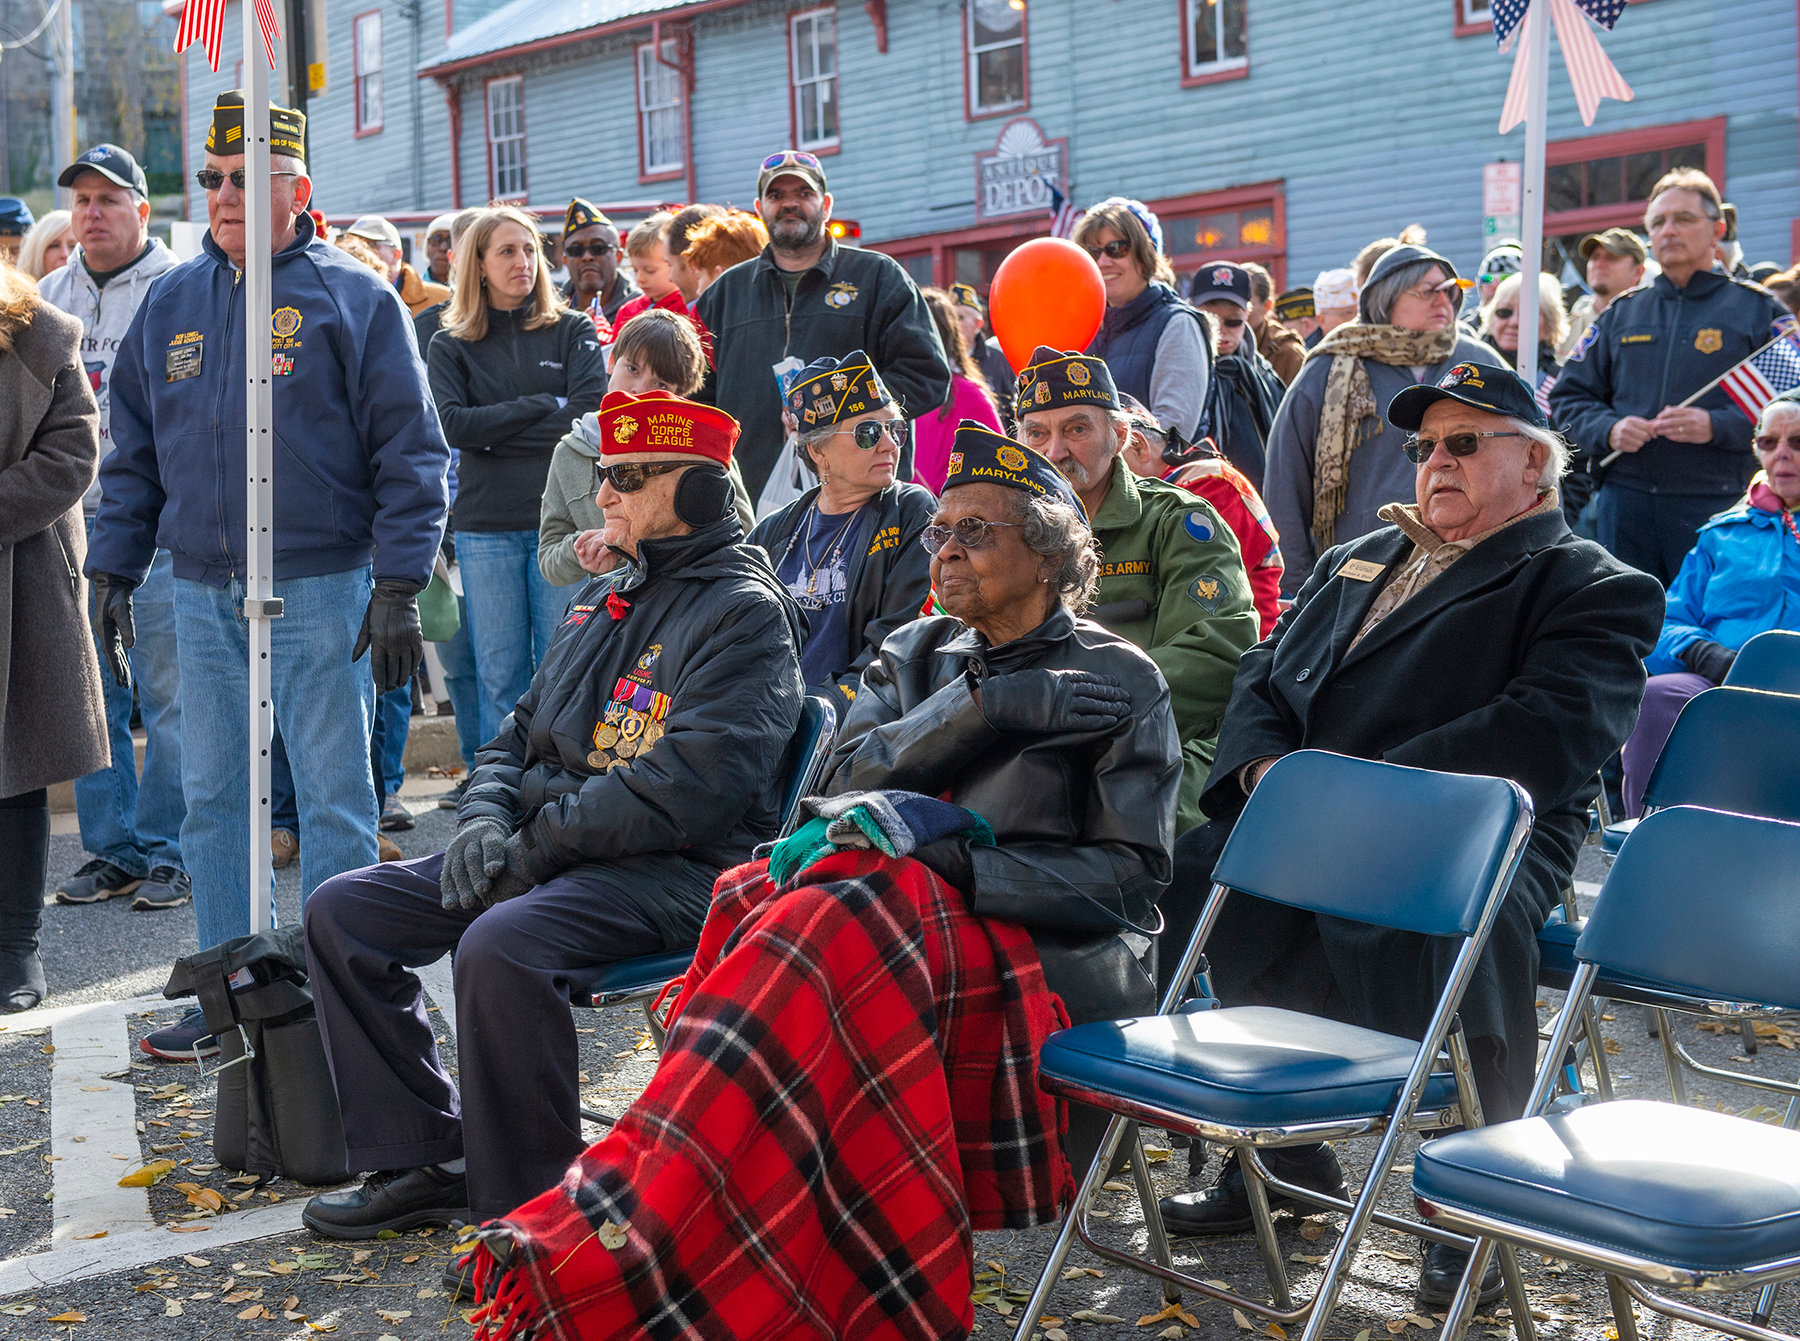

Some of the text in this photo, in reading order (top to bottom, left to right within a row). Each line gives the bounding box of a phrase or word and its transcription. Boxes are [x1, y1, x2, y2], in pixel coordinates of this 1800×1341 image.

[985, 154, 1058, 178] ANTIQUE
[985, 173, 1059, 210] DEPOT
[80, 338, 98, 352] IR
[1063, 389, 1111, 401] MARYLAND
[848, 402, 865, 413] 156
[647, 413, 694, 429] MARINE
[651, 425, 690, 437] CORPS
[647, 435, 694, 447] LEAGUE
[971, 467, 1046, 494] MARYLAND
[833, 592, 846, 602] CI
